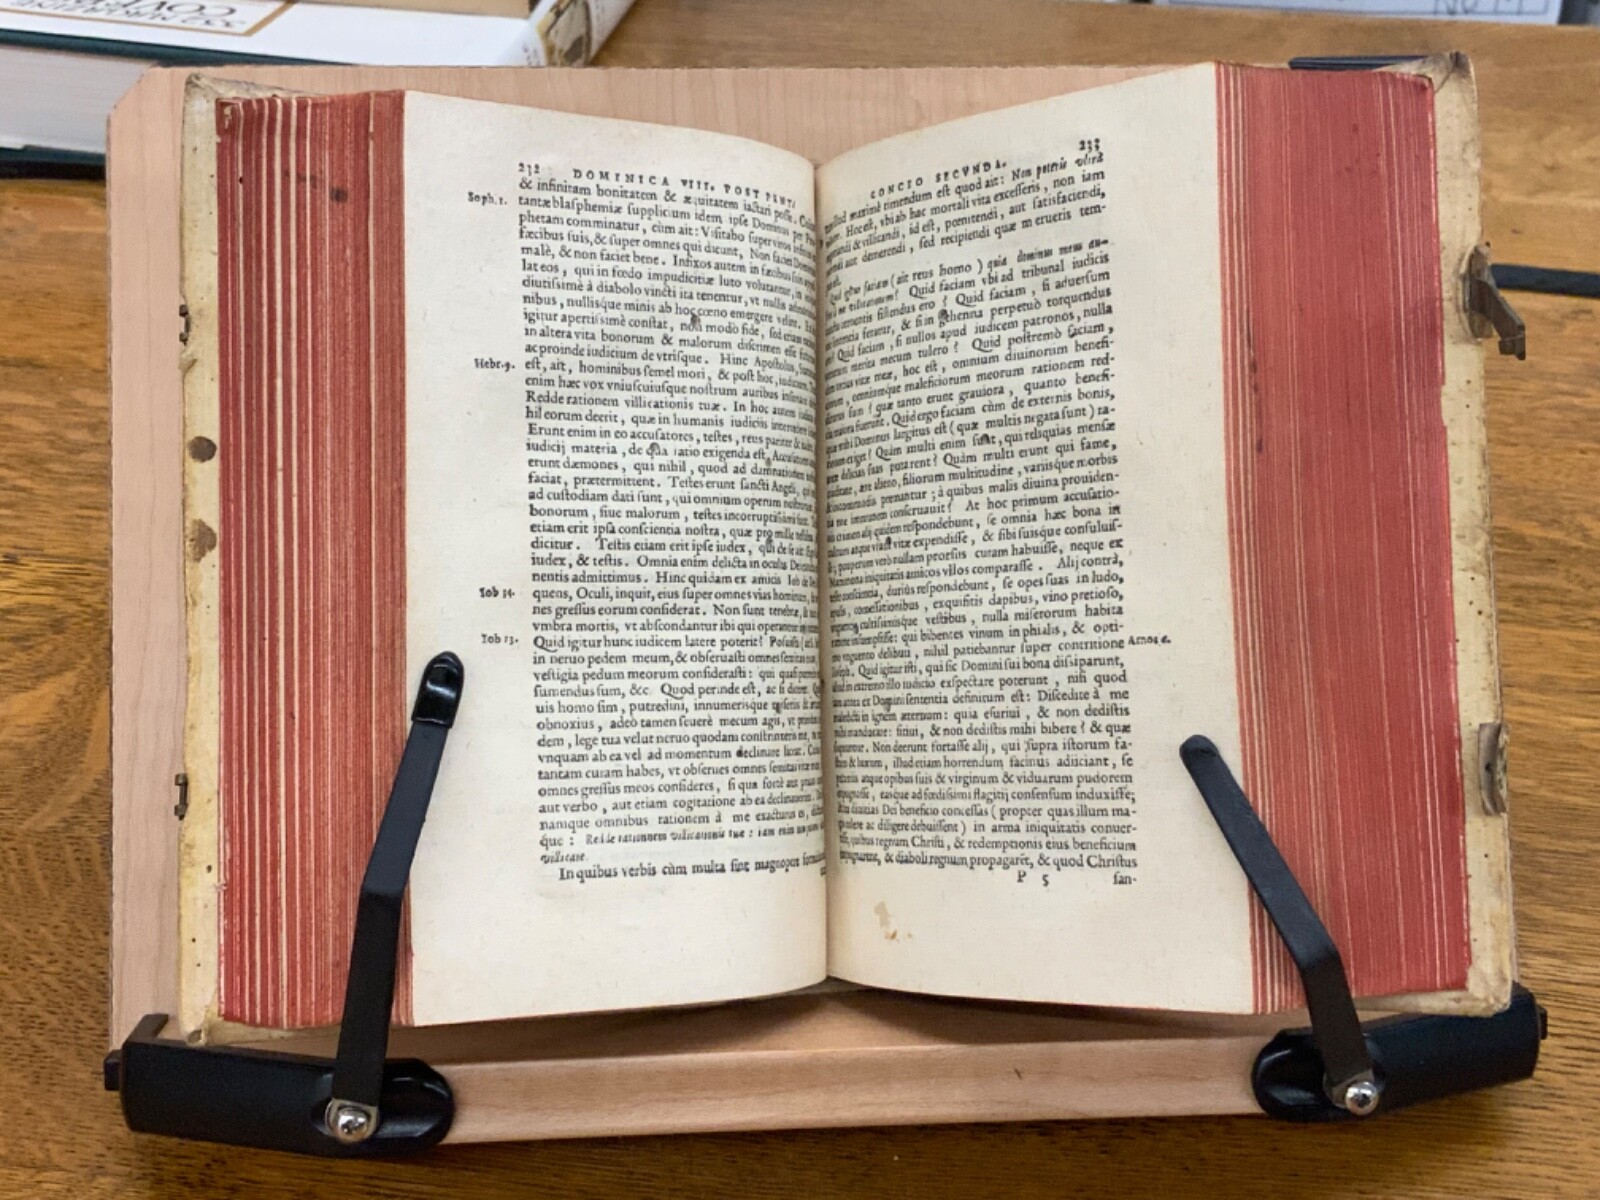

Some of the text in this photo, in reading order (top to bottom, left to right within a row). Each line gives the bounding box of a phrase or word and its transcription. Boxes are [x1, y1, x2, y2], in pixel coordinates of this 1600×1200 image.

[954, 176, 982, 196] quod
[1052, 175, 1075, 189] non
[1081, 169, 1105, 185] iam
[663, 188, 676, 202] &
[642, 238, 702, 255] omnes qui
[573, 249, 746, 273] non autem
[573, 266, 594, 278] qui
[718, 273, 742, 288] luto
[908, 280, 935, 300] Quid
[938, 277, 975, 292] faciam
[1021, 258, 1065, 279] tribunal
[911, 263, 972, 281] reus homo
[596, 280, 642, 295] diabolo
[623, 299, 655, 313] minis
[939, 301, 1113, 343] apud iudicem nulla
[600, 328, 732, 349] bonorum malorum
[970, 334, 1001, 353] Quid
[586, 343, 638, 360] iudicium
[640, 348, 654, 361] de
[902, 364, 920, 377] hoc
[1004, 345, 1068, 362] diuinorum
[975, 366, 1024, 382] meorum
[1031, 358, 1085, 374] rationem
[582, 380, 604, 390] vox
[1023, 377, 1067, 395] quanto
[525, 390, 564, 404] Redde
[565, 392, 619, 407] rationem
[623, 394, 694, 410] villicationis
[985, 412, 1022, 429] multis
[566, 424, 597, 438] enim
[939, 438, 966, 451] enim
[1018, 438, 1075, 458] erunt qui
[697, 460, 728, 477] quod
[610, 489, 635, 502] dati
[945, 482, 984, 501] quibus
[988, 478, 1018, 493] malis
[1021, 476, 1059, 490] diuina
[1011, 494, 1059, 511] primum
[1000, 504, 1102, 524] omnia bona
[529, 520, 565, 534] etiam
[668, 538, 689, 551] erit
[1069, 540, 1104, 554] neque
[635, 554, 678, 567] Omnia
[1041, 589, 1069, 602] vino
[597, 602, 740, 616] eorum Non
[981, 602, 1124, 622] nulla habita
[532, 634, 565, 652] Quid
[587, 650, 627, 668] pedem
[581, 667, 679, 685] pedum meorum
[998, 669, 1128, 690] poterunt quod
[659, 682, 695, 700] Quod
[557, 699, 594, 713] homo
[639, 716, 758, 728] tamen mecum
[953, 708, 1080, 724] quia non
[1009, 721, 1077, 735] mihi bibere
[574, 731, 654, 750] lege velut
[664, 749, 732, 759] momentum
[947, 771, 1133, 788] virginum pudorem
[623, 784, 655, 794] meos
[594, 813, 648, 827] omnibus
[990, 823, 1021, 833] arma
[1045, 839, 1070, 850] eius
[621, 864, 657, 877] verbis
[1052, 854, 1084, 872] quod
